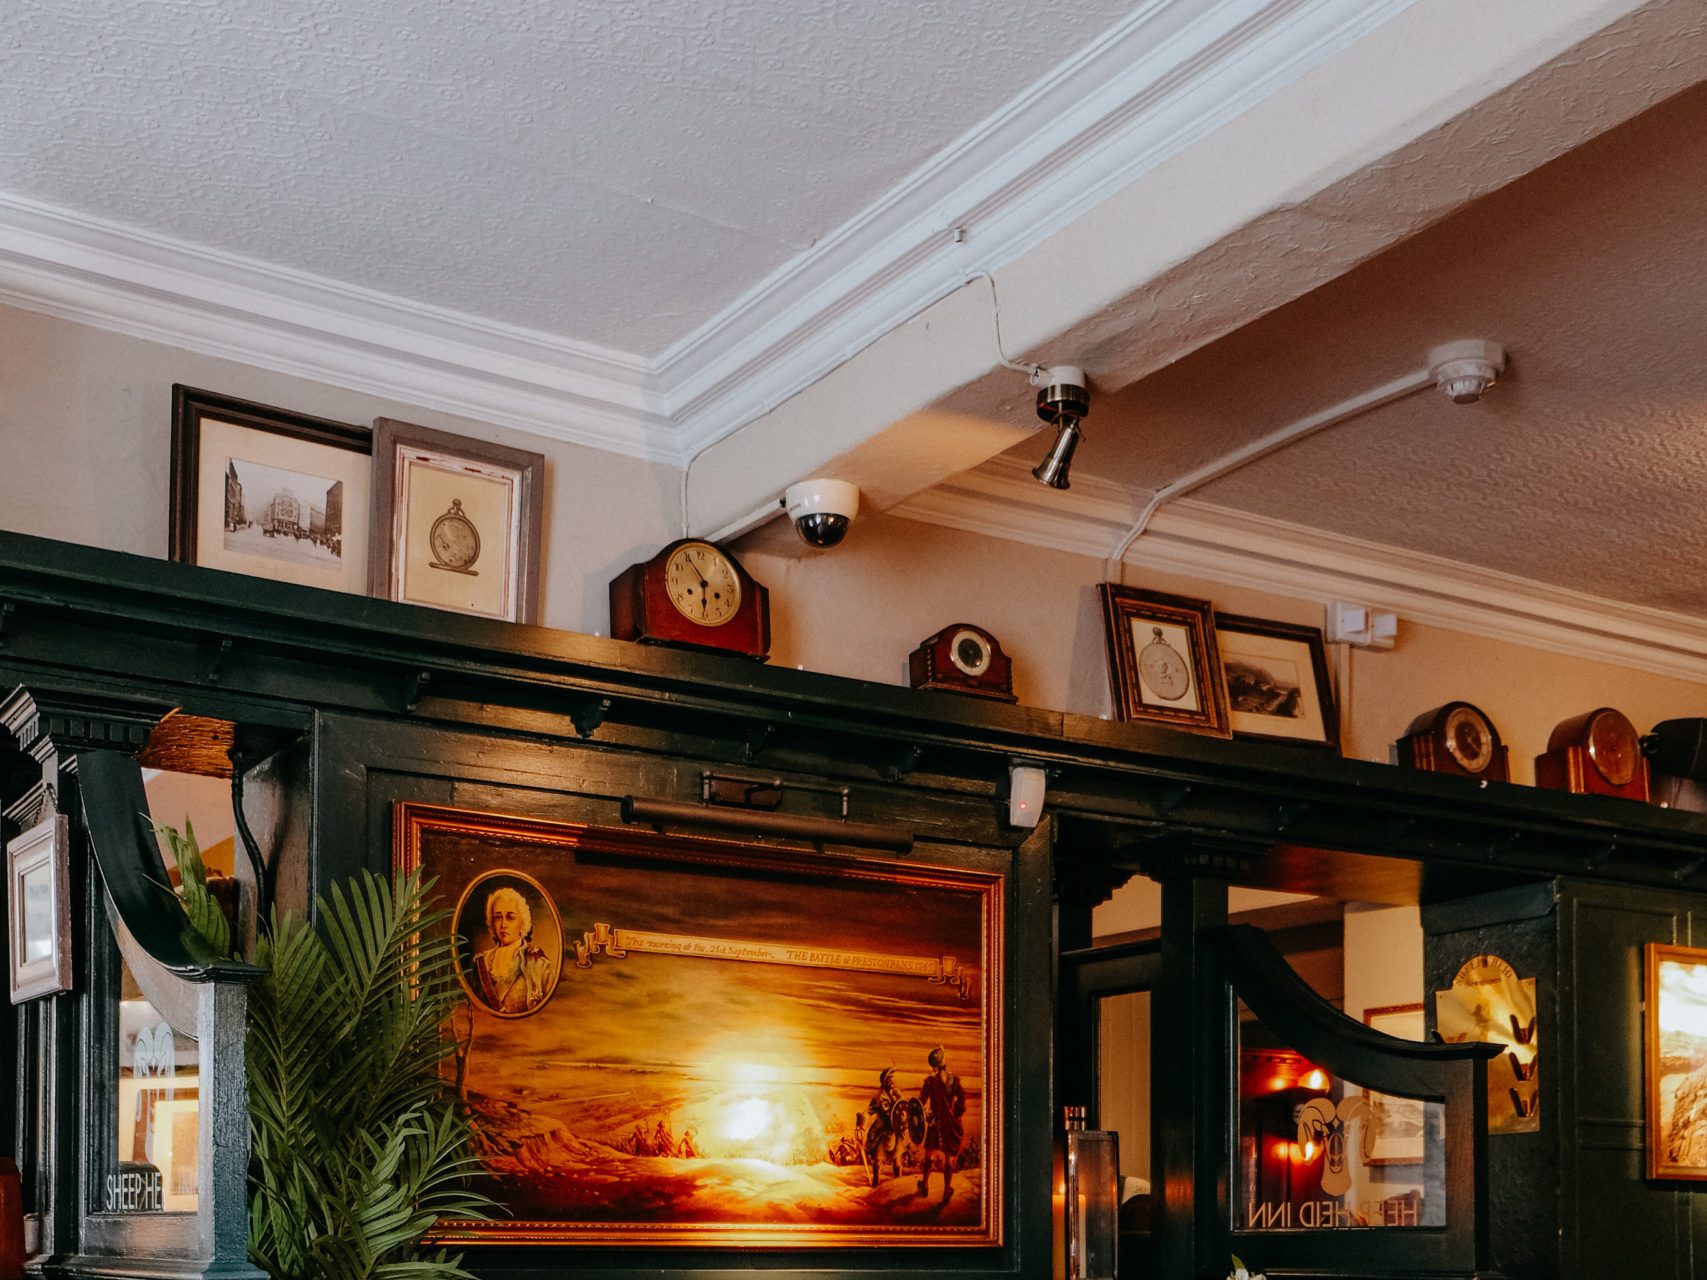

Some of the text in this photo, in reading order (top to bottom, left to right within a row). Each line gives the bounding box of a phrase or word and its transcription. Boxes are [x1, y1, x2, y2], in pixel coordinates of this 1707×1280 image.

[696, 549, 705, 561] 12
[673, 561, 684, 572] 10
[671, 576, 678, 585] 9
[625, 936, 643, 947] The
[786, 950, 808, 961] THE
[809, 952, 841, 964] BATTLE
[106, 1173, 141, 1211] SHEEP
